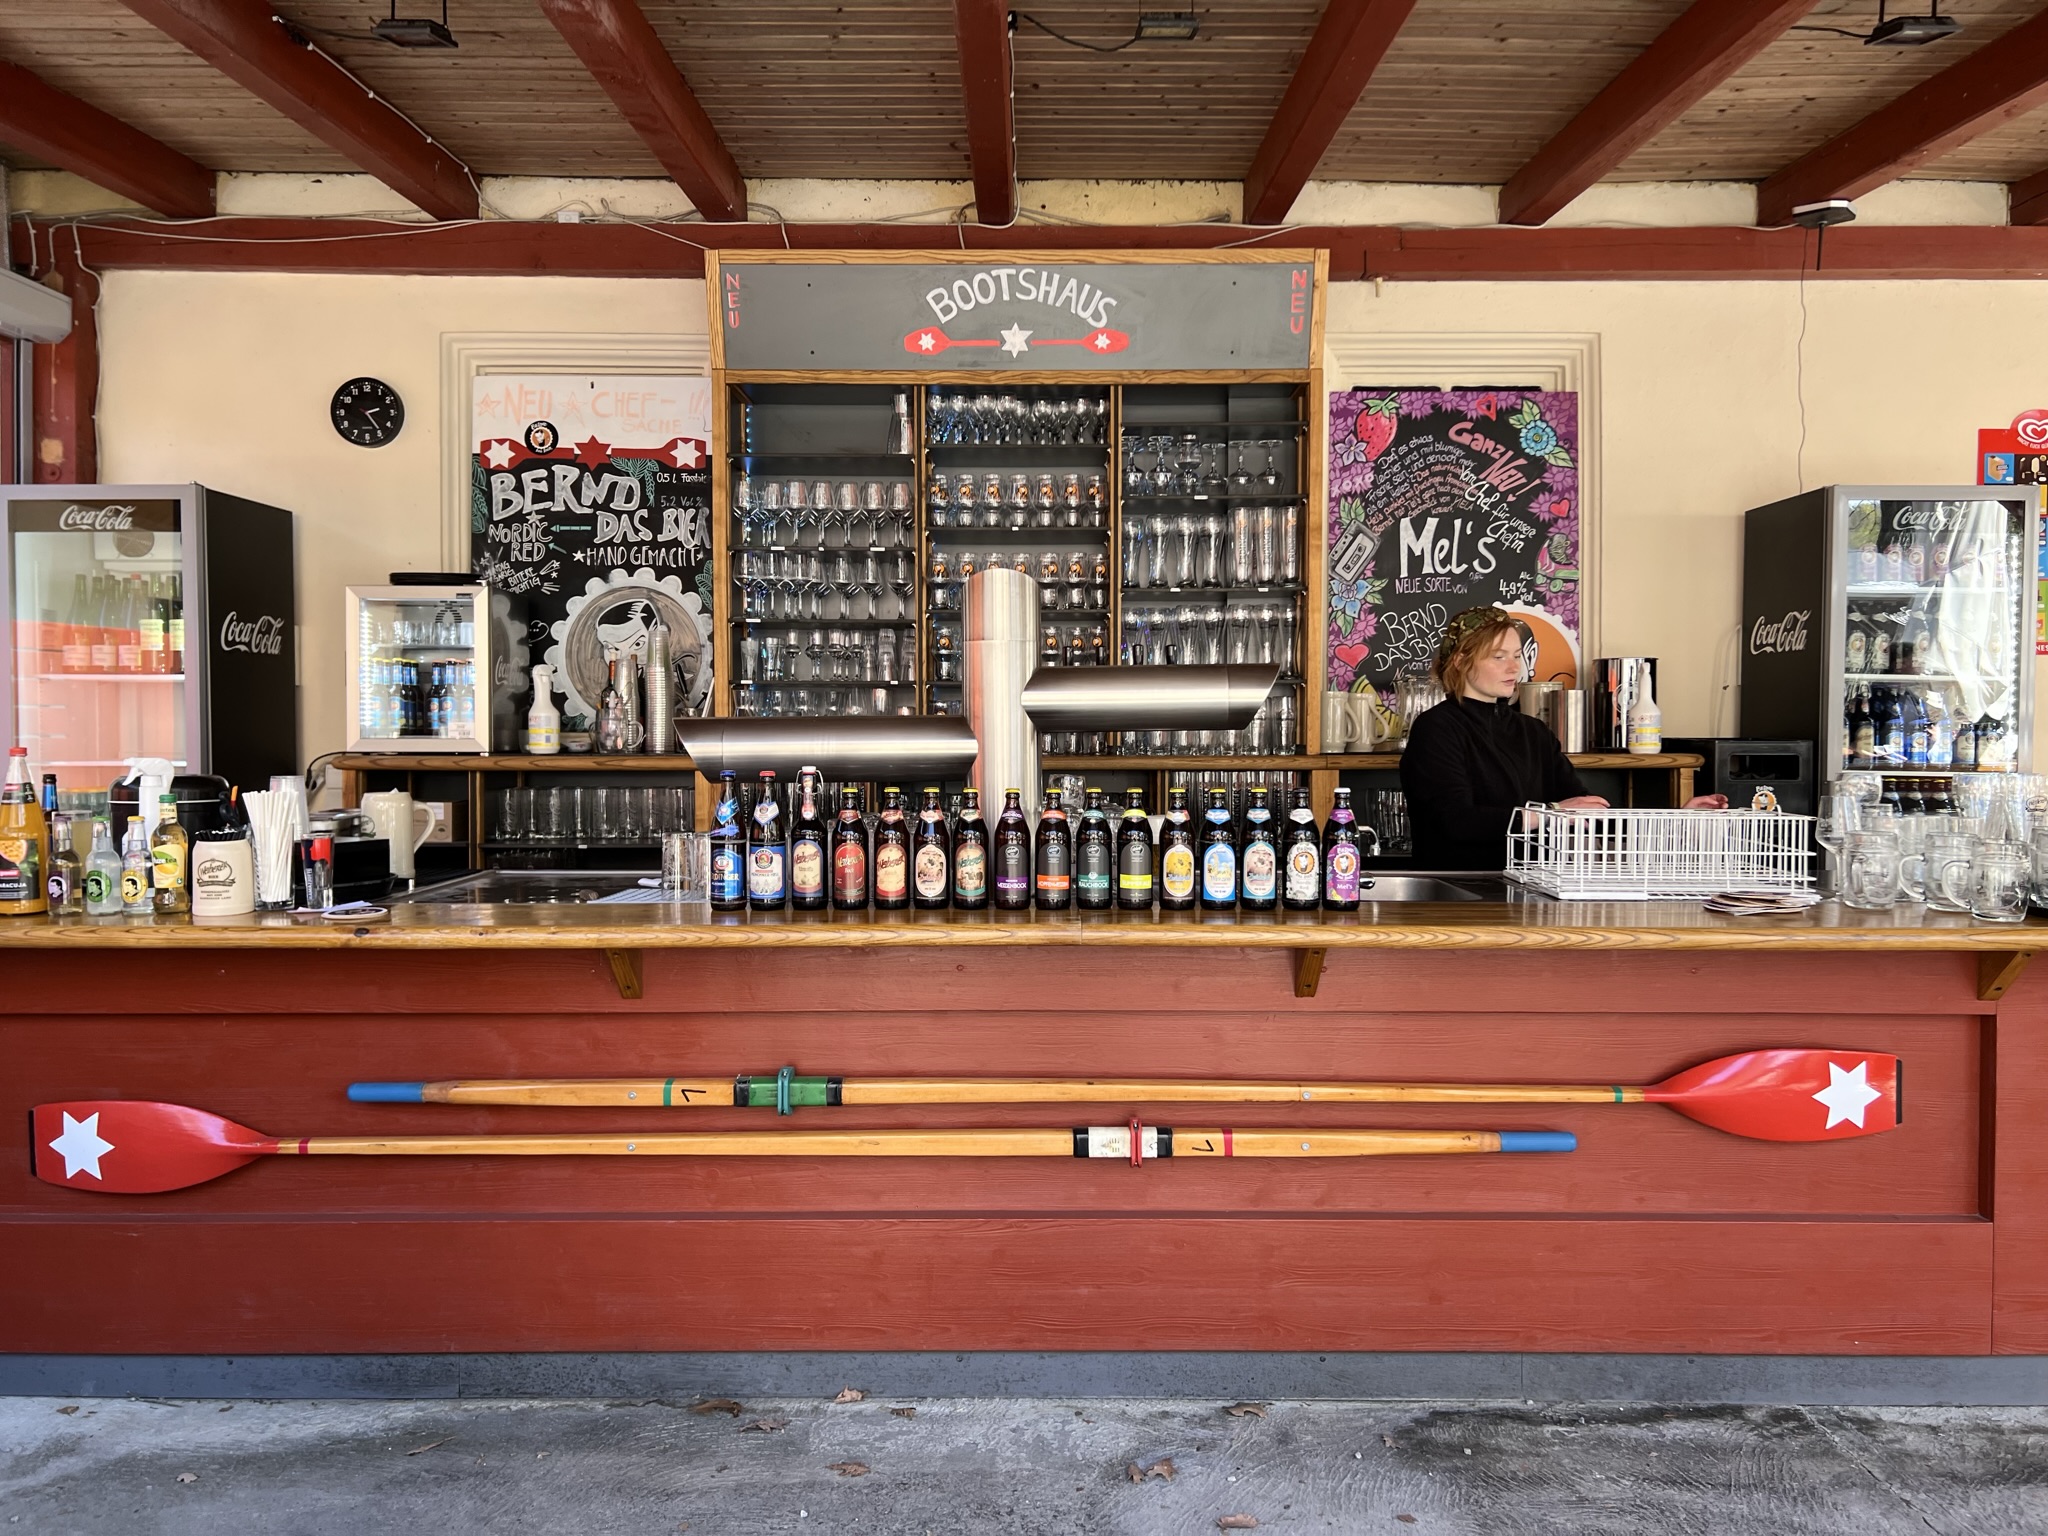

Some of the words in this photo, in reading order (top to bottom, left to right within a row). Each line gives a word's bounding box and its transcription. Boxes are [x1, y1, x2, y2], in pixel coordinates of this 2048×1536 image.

[725, 272, 741, 329] NEU
[925, 268, 1118, 329] BOOTSHAUS
[1290, 269, 1307, 334] NEU
[385, 396, 391, 404] 2
[504, 384, 551, 426] NEU
[344, 420, 349, 428] 8
[353, 429, 359, 437] 7
[377, 429, 382, 437] 5
[621, 418, 683, 434] SACHE
[1408, 434, 1434, 449] etwas
[490, 465, 641, 522] BERND
[1464, 481, 1500, 513] Chef
[488, 521, 553, 543] NORDIC
[594, 508, 653, 544] DAS
[657, 507, 712, 549] BIER
[510, 542, 546, 562] RED
[1399, 517, 1497, 578] Mel's
[1395, 578, 1422, 594] NEUE
[1423, 577, 1452, 593] SORTE
[1380, 602, 1448, 647] BERND
[1374, 643, 1412, 672] DAS
